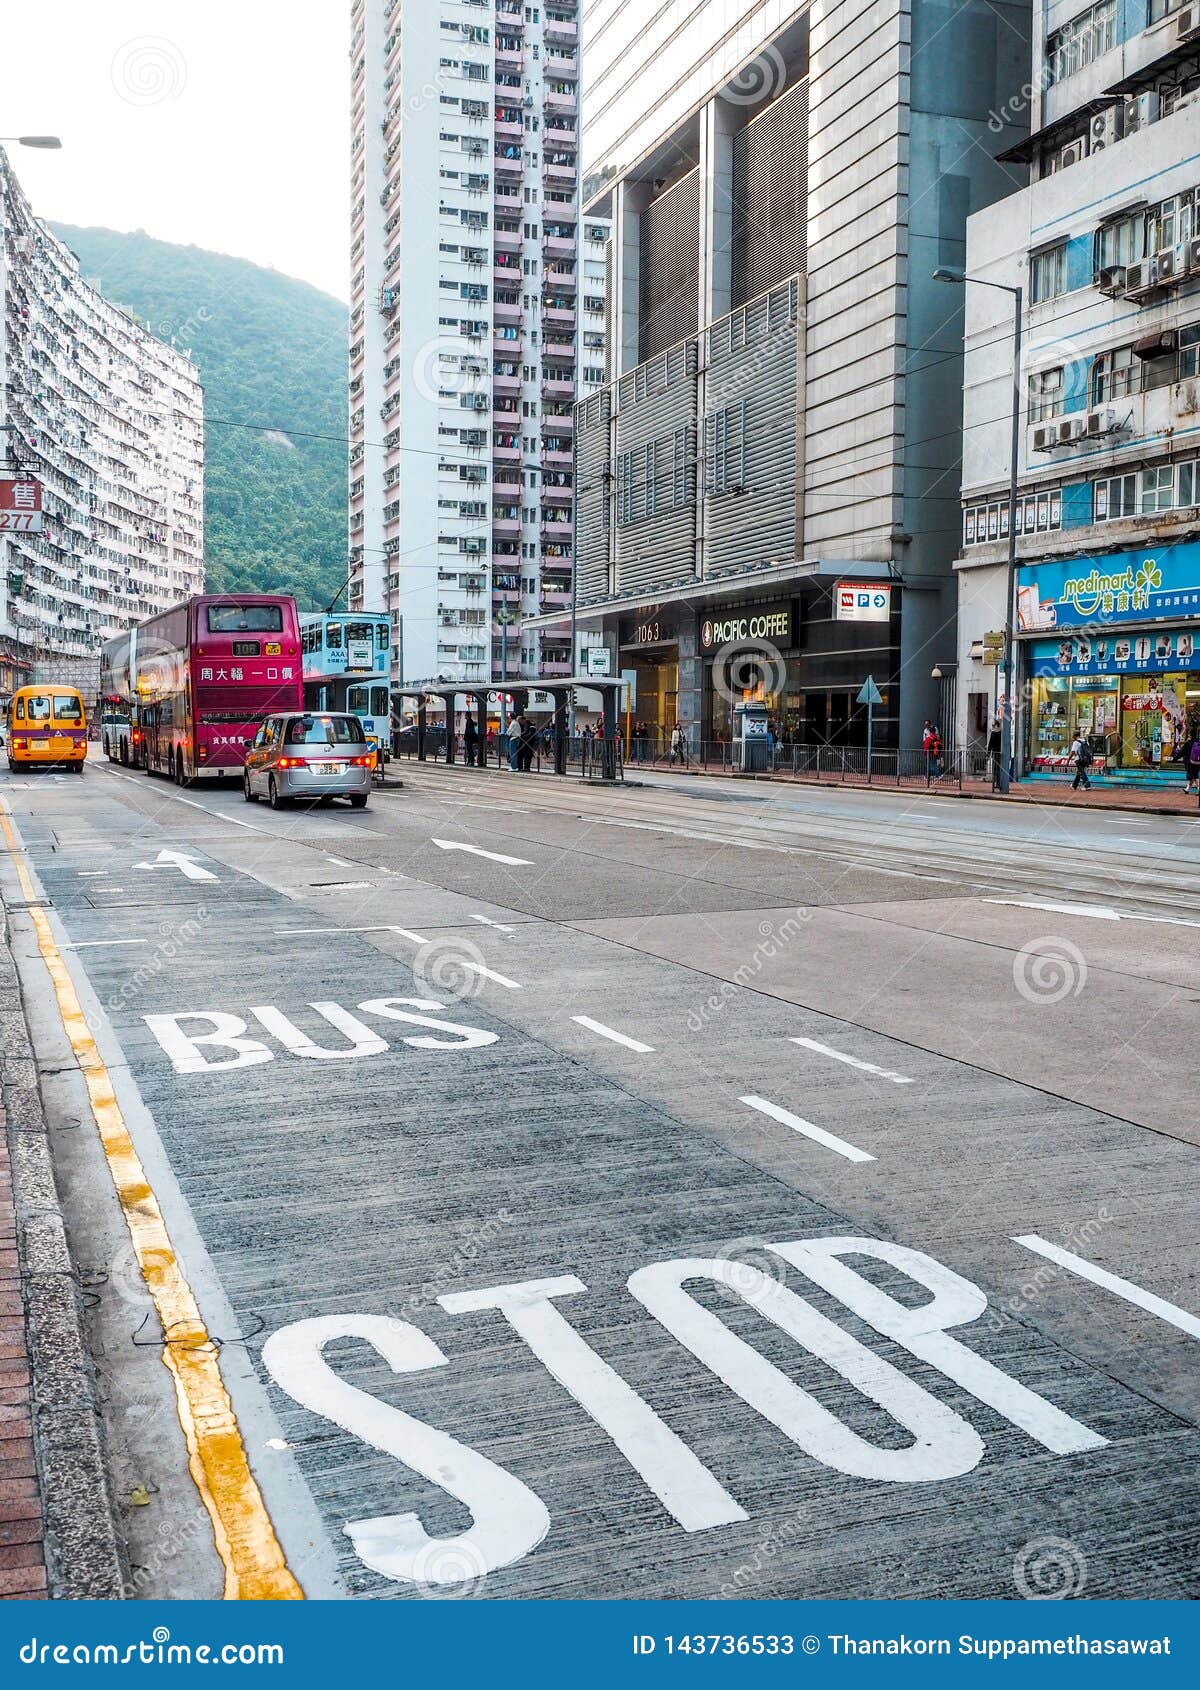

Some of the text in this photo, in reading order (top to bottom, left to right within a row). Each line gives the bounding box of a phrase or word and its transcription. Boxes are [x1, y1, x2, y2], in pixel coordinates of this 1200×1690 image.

[12, 482, 36, 509] 售
[1059, 566, 1134, 608] medimart
[637, 622, 660, 643] 1063
[713, 612, 788, 643] PACIFIC COFFEE
[330, 650, 345, 658] AXA
[201, 667, 293, 681] 周大福 一口價
[141, 997, 500, 1074] BUS
[260, 1236, 1112, 1584] STOP
